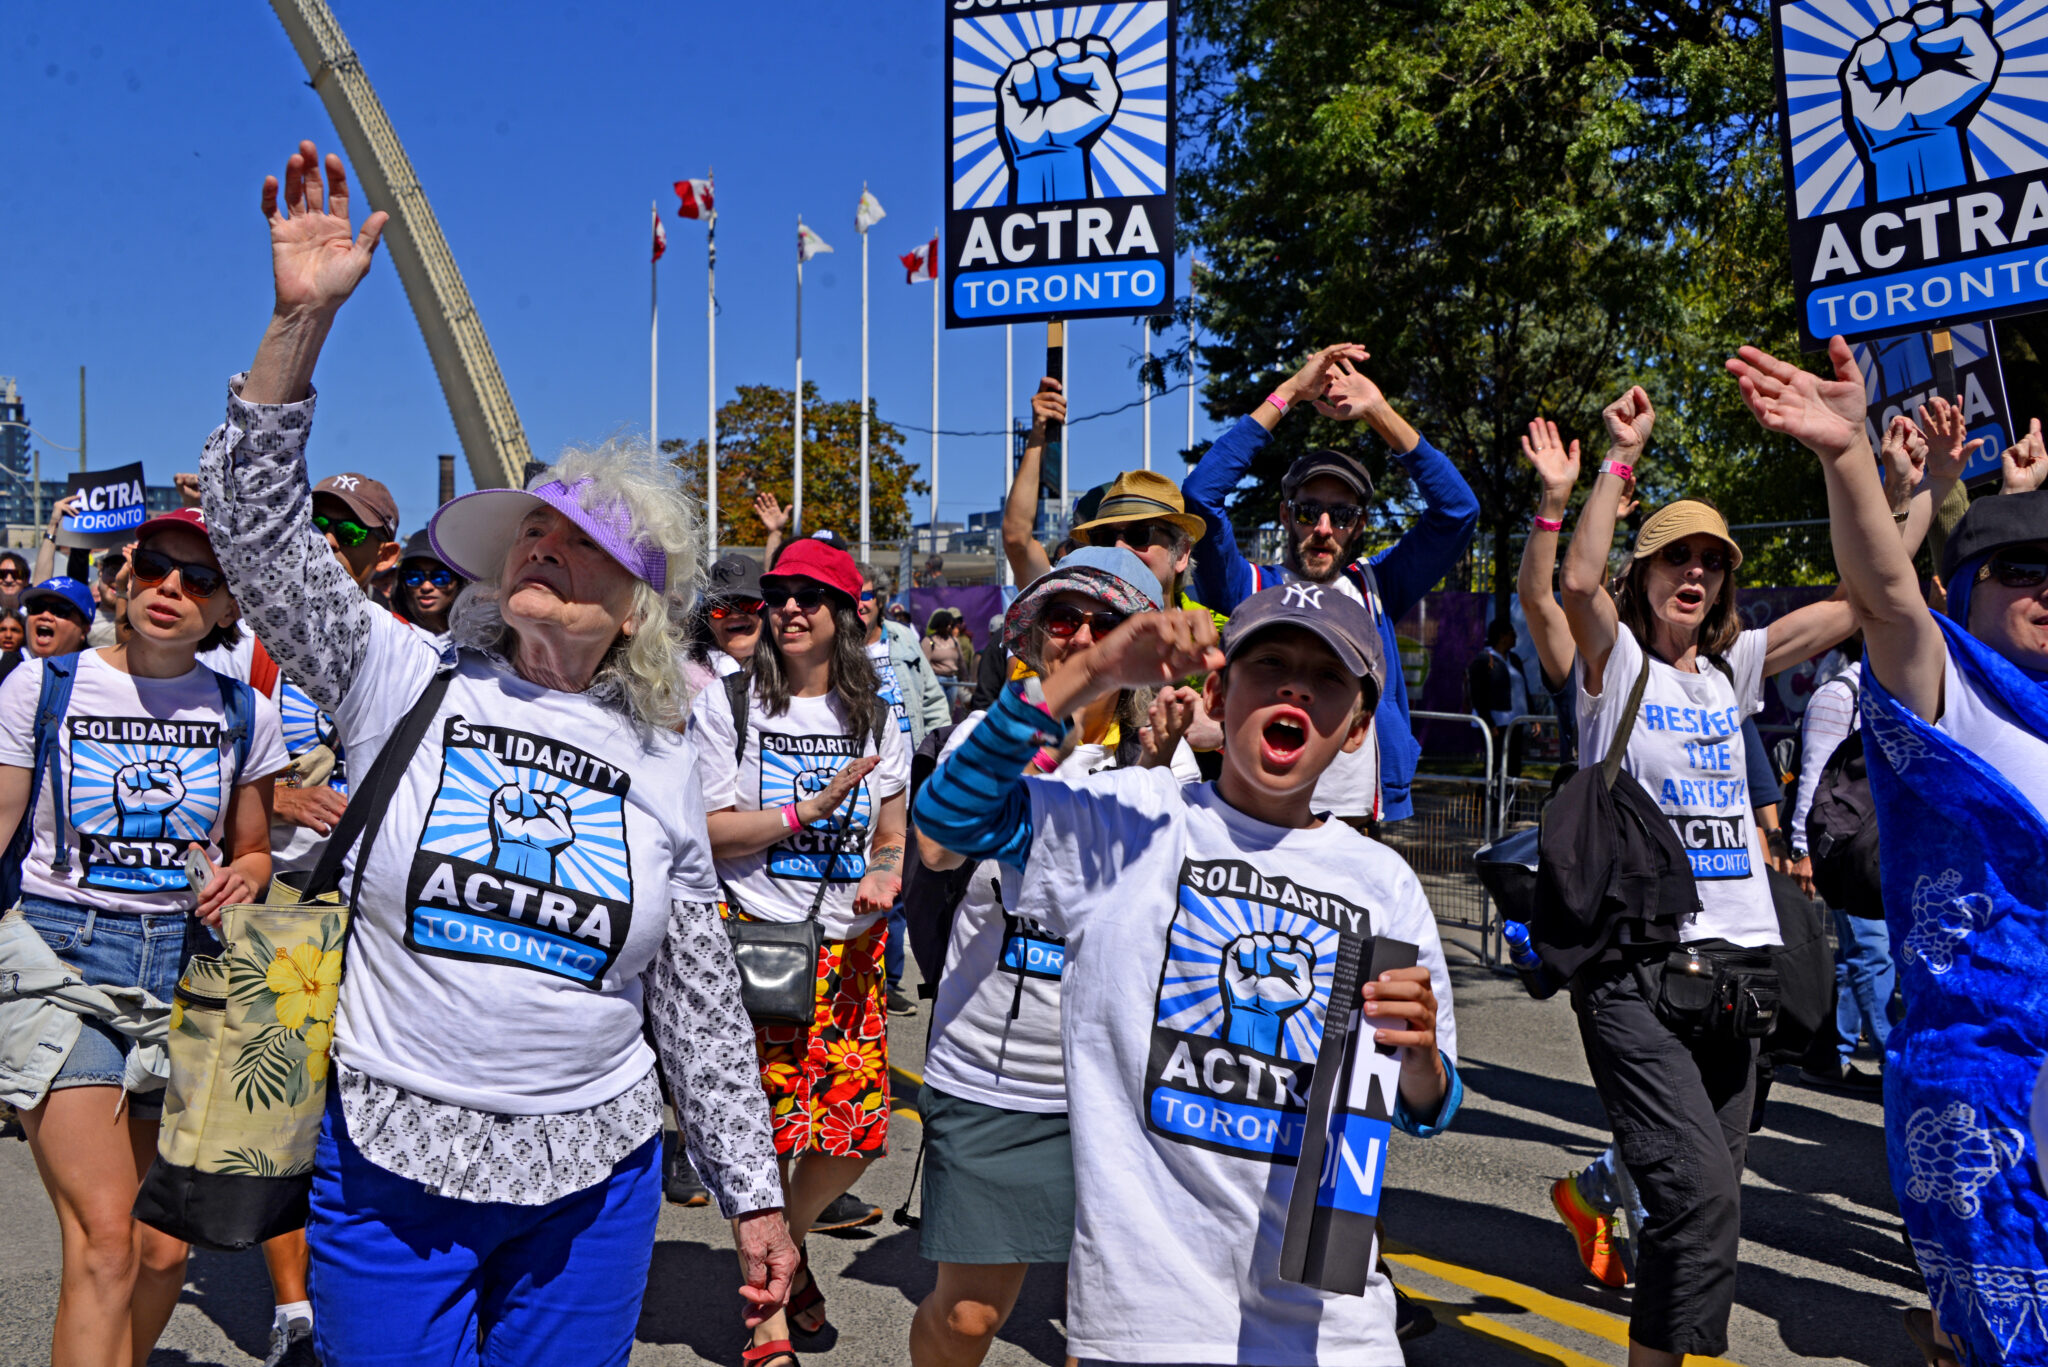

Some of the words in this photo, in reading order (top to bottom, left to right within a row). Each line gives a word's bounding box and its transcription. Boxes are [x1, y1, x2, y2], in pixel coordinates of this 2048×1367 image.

[958, 204, 1159, 268] ACTRA
[1810, 180, 2048, 283] ACTRA
[962, 269, 1156, 309] TORONTO
[70, 480, 144, 512] ACTRA
[73, 508, 143, 530] TORONTO
[73, 720, 216, 745] SOLIDARITY
[763, 736, 860, 755] SOLIDARITY
[1683, 742, 1731, 771] THE
[1659, 778, 1746, 808] ARTIST!
[418, 862, 612, 949] ACTRA
[1187, 864, 1364, 934] SOLIDARITY
[419, 915, 598, 973] TORONTO
[1160, 1040, 1312, 1108] ACTR
